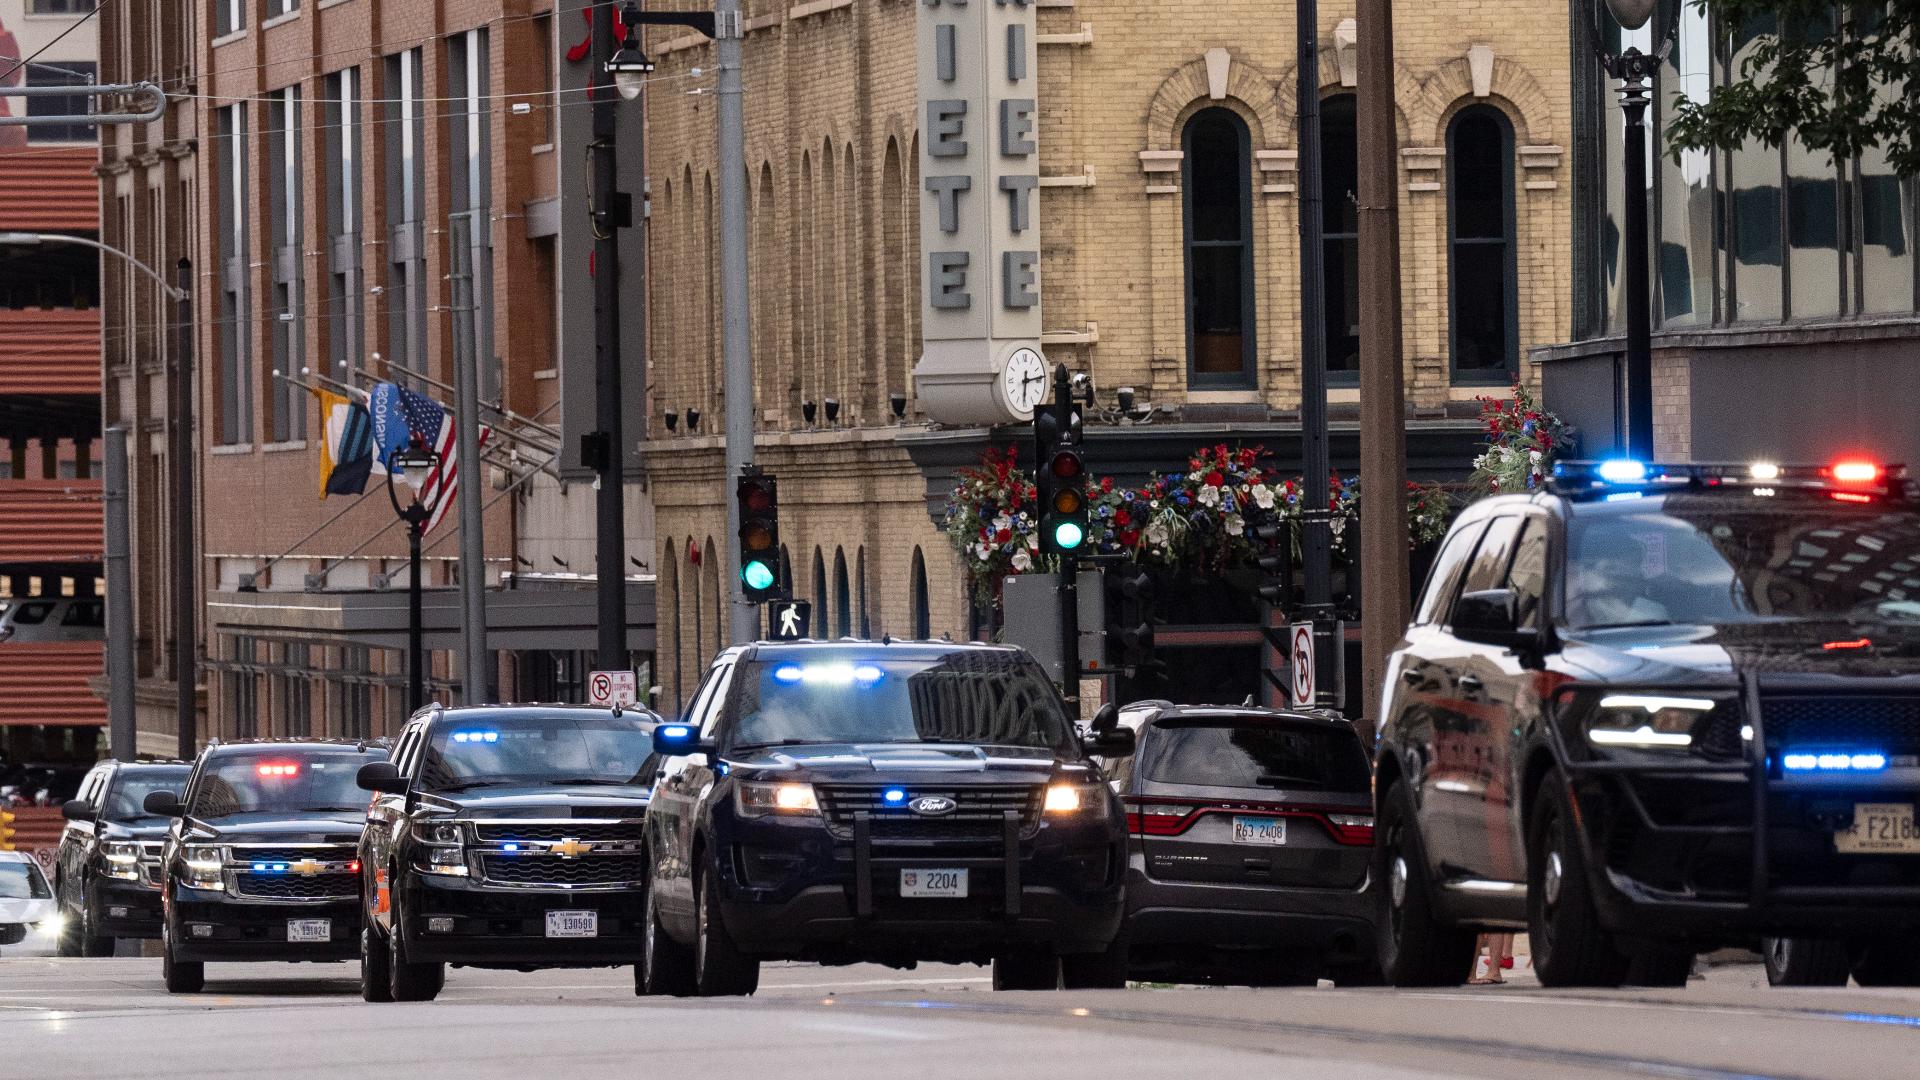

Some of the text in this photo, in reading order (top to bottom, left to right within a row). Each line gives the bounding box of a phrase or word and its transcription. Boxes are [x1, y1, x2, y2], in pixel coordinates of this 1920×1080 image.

[923, 0, 971, 308] IETE
[996, 0, 1040, 309] IETE
[919, 798, 947, 811] Ford
[1236, 823, 1283, 839] R63 2408
[927, 873, 958, 889] 2204
[563, 918, 593, 930] 130598
